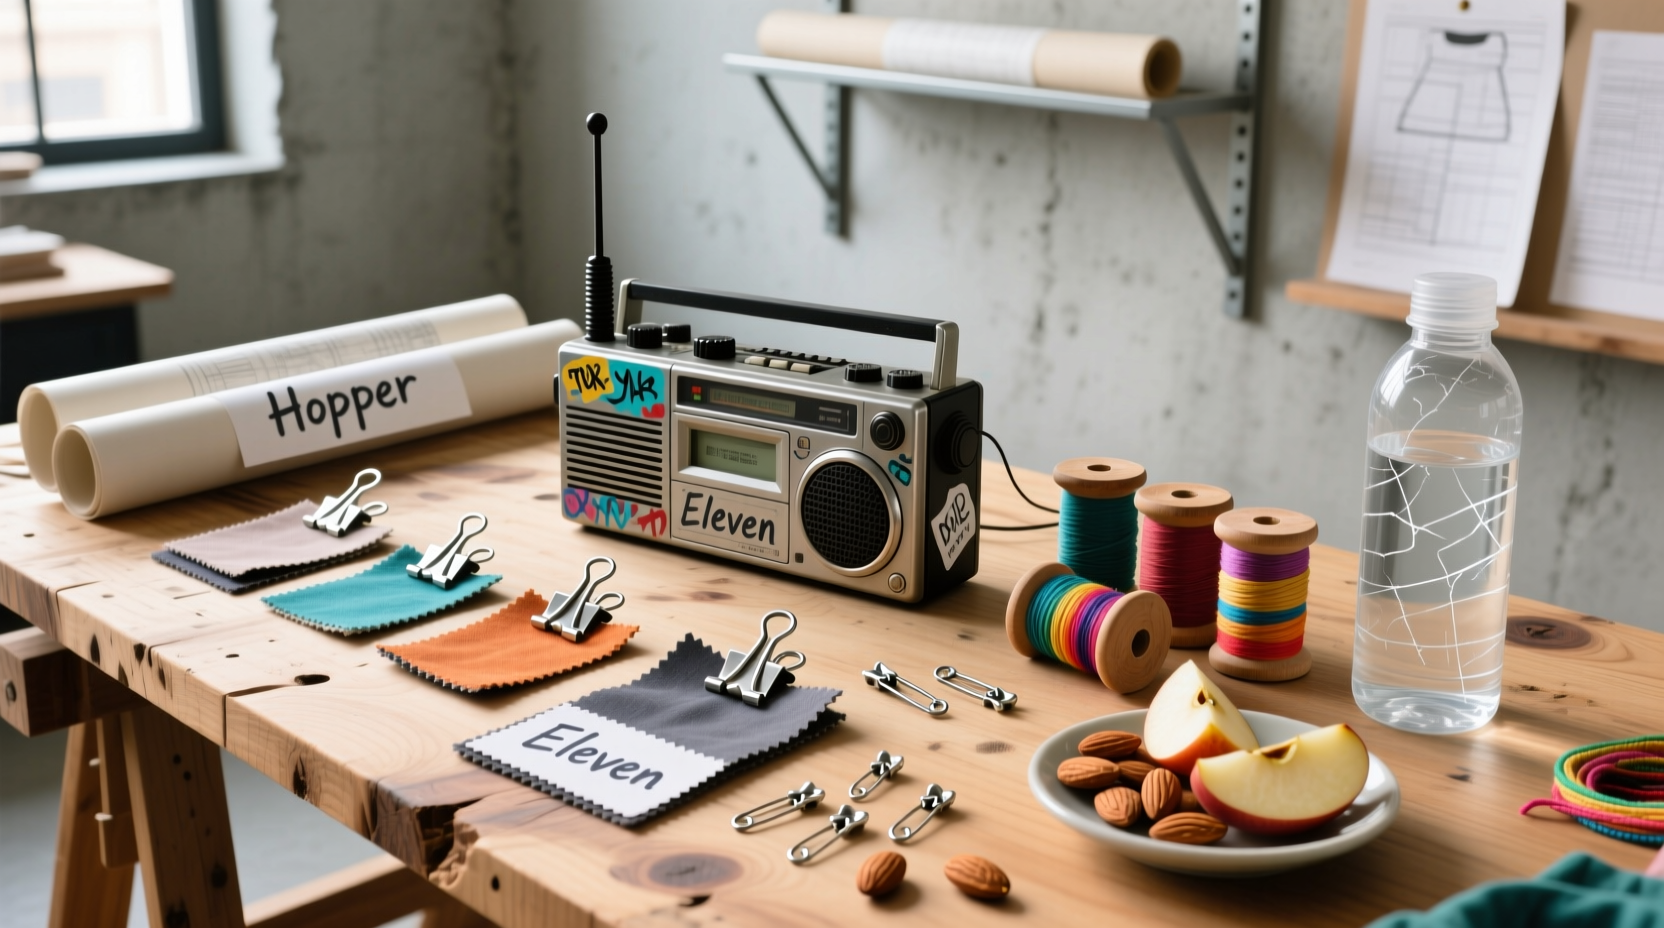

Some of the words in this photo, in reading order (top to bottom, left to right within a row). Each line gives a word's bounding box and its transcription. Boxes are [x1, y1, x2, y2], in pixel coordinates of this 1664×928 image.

[267, 375, 417, 439] Hopper
[680, 491, 775, 546] Eleven
[522, 723, 663, 790] Eleven
